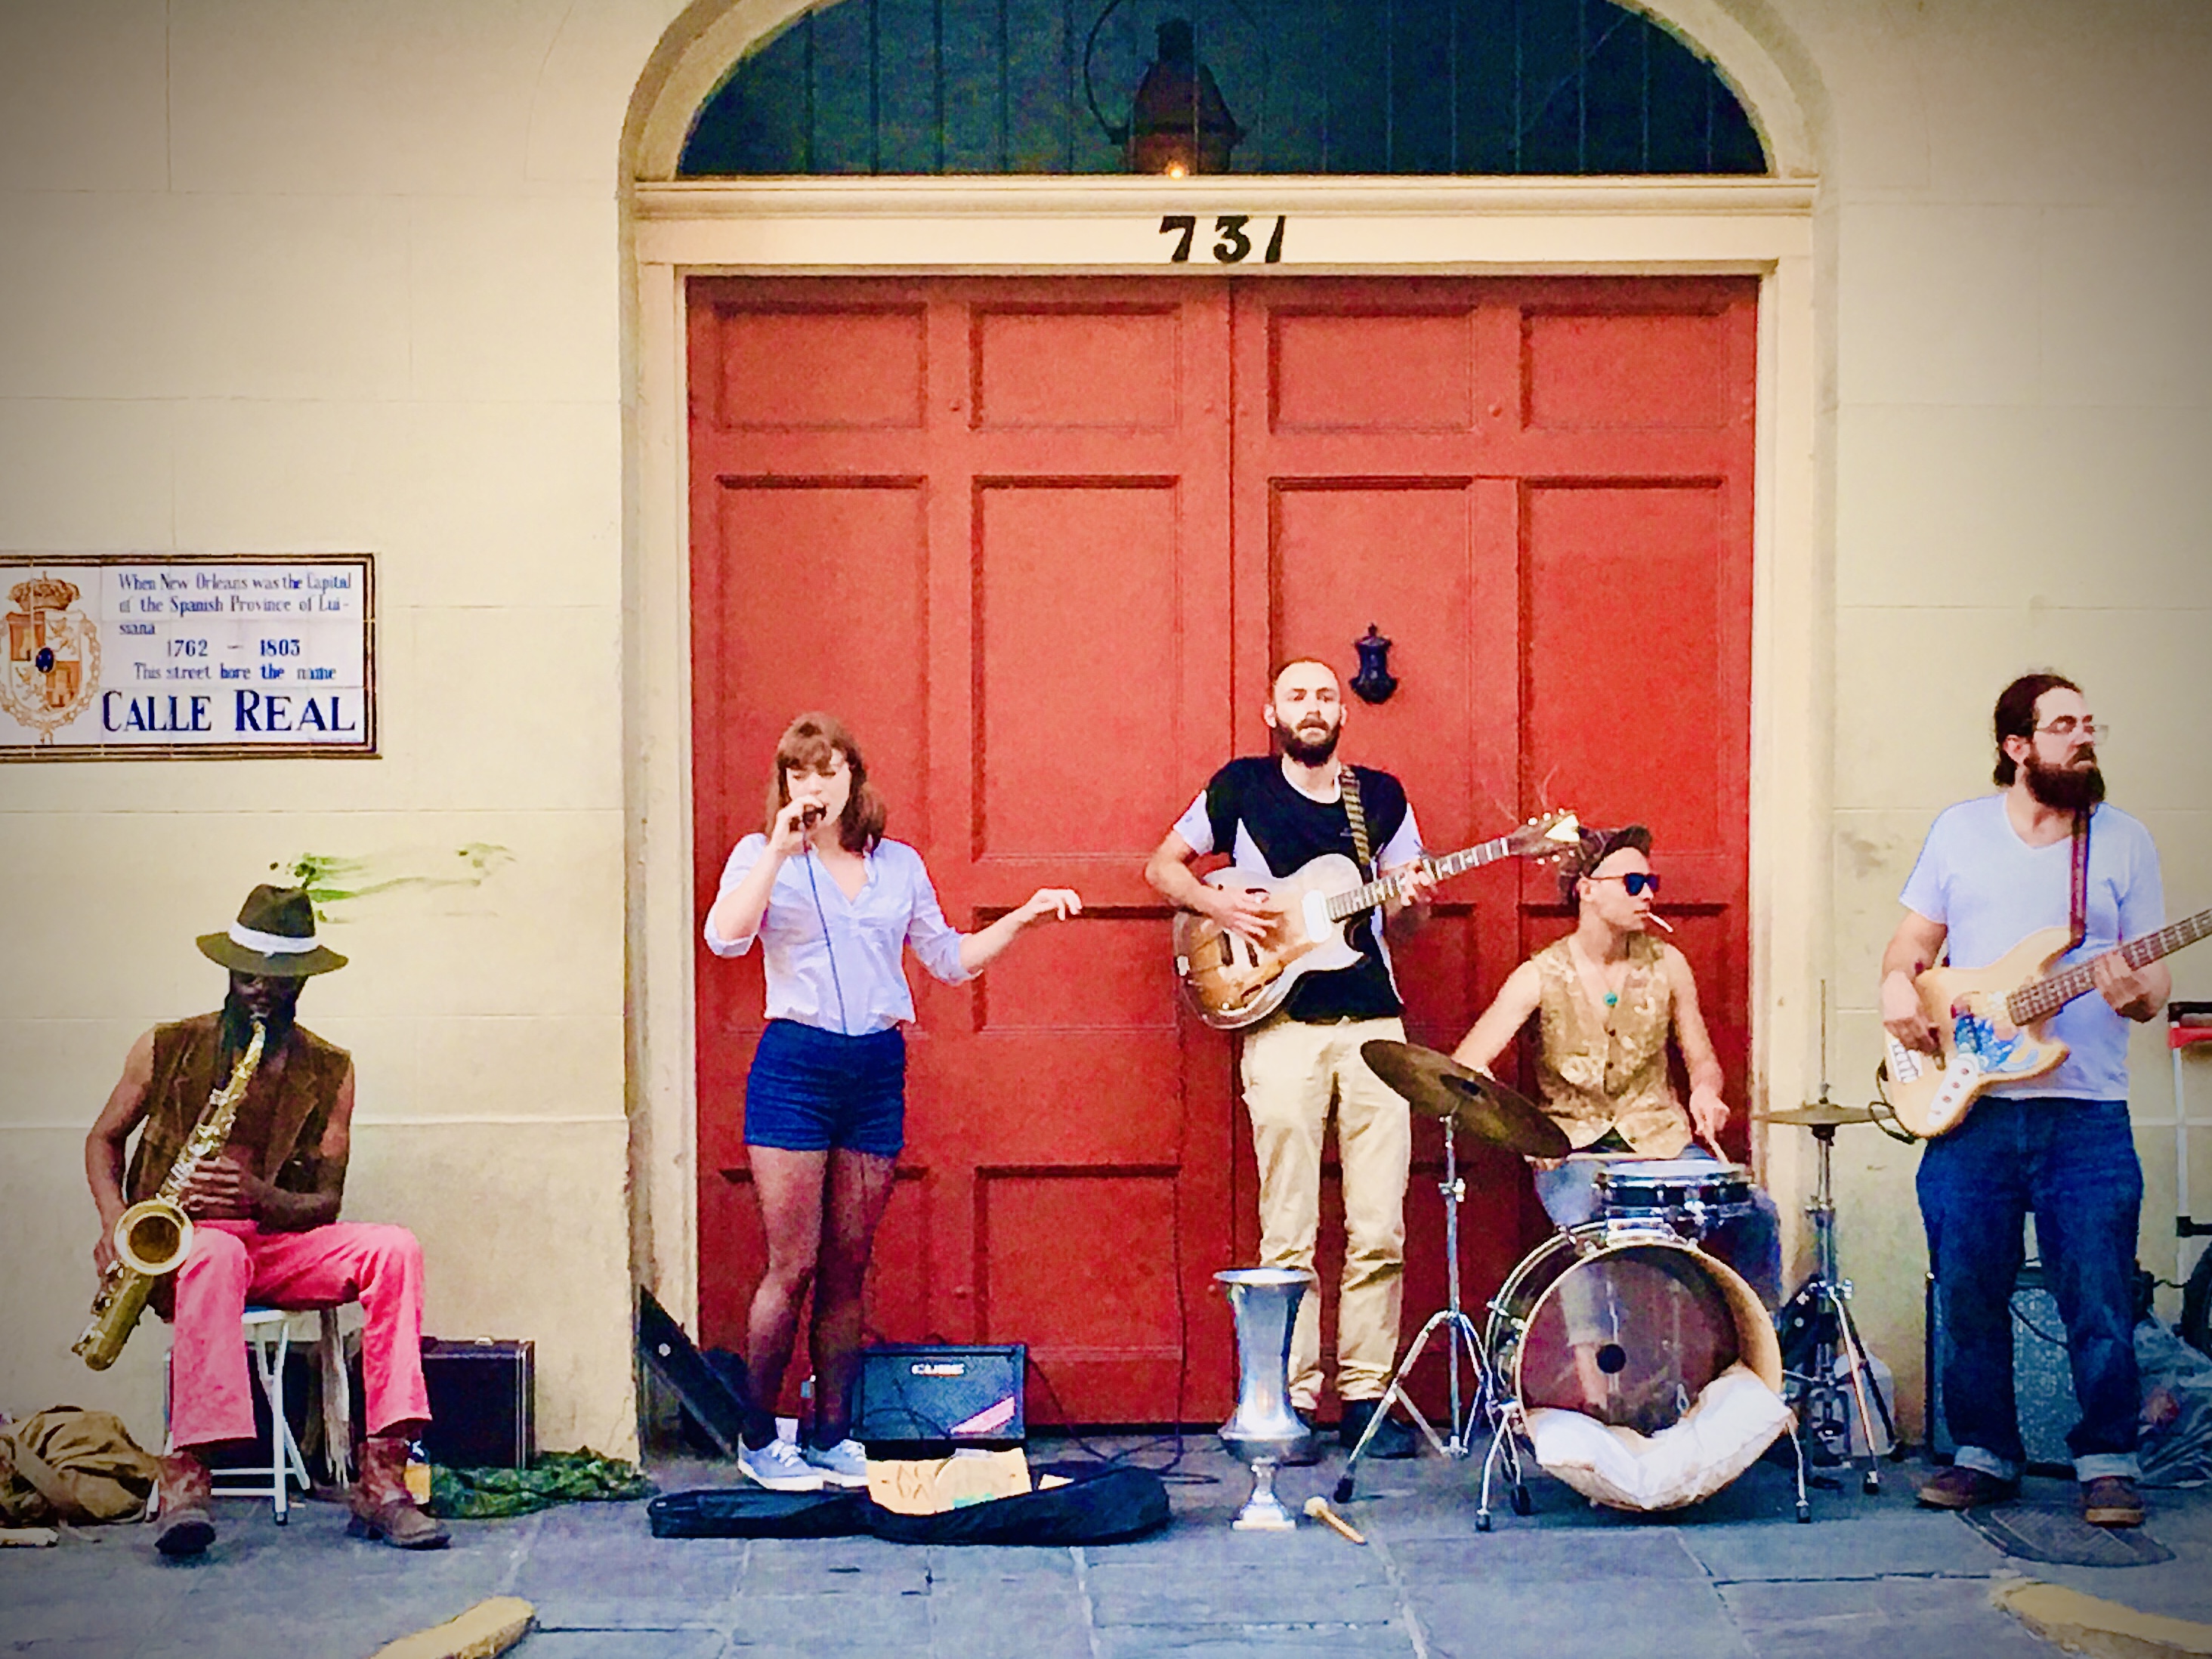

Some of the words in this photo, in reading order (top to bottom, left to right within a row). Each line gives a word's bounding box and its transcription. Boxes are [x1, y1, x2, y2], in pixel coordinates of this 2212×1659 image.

[1159, 215, 1287, 263] 731
[119, 573, 156, 590] When
[160, 573, 188, 590] New
[195, 573, 248, 590] Orleans
[252, 579, 280, 589] was
[283, 573, 302, 589] the
[307, 572, 351, 594] Capital
[141, 596, 163, 612] the
[170, 595, 224, 617] Spanish
[230, 595, 292, 612] Province
[299, 595, 314, 612] of
[167, 639, 208, 657] 1762
[260, 639, 300, 656] 1803
[134, 662, 161, 679] This
[165, 666, 212, 680] street
[220, 663, 251, 680] bore
[260, 663, 284, 679] the
[297, 667, 336, 680] name
[103, 690, 212, 731] CALLE
[233, 689, 355, 731] REAL
